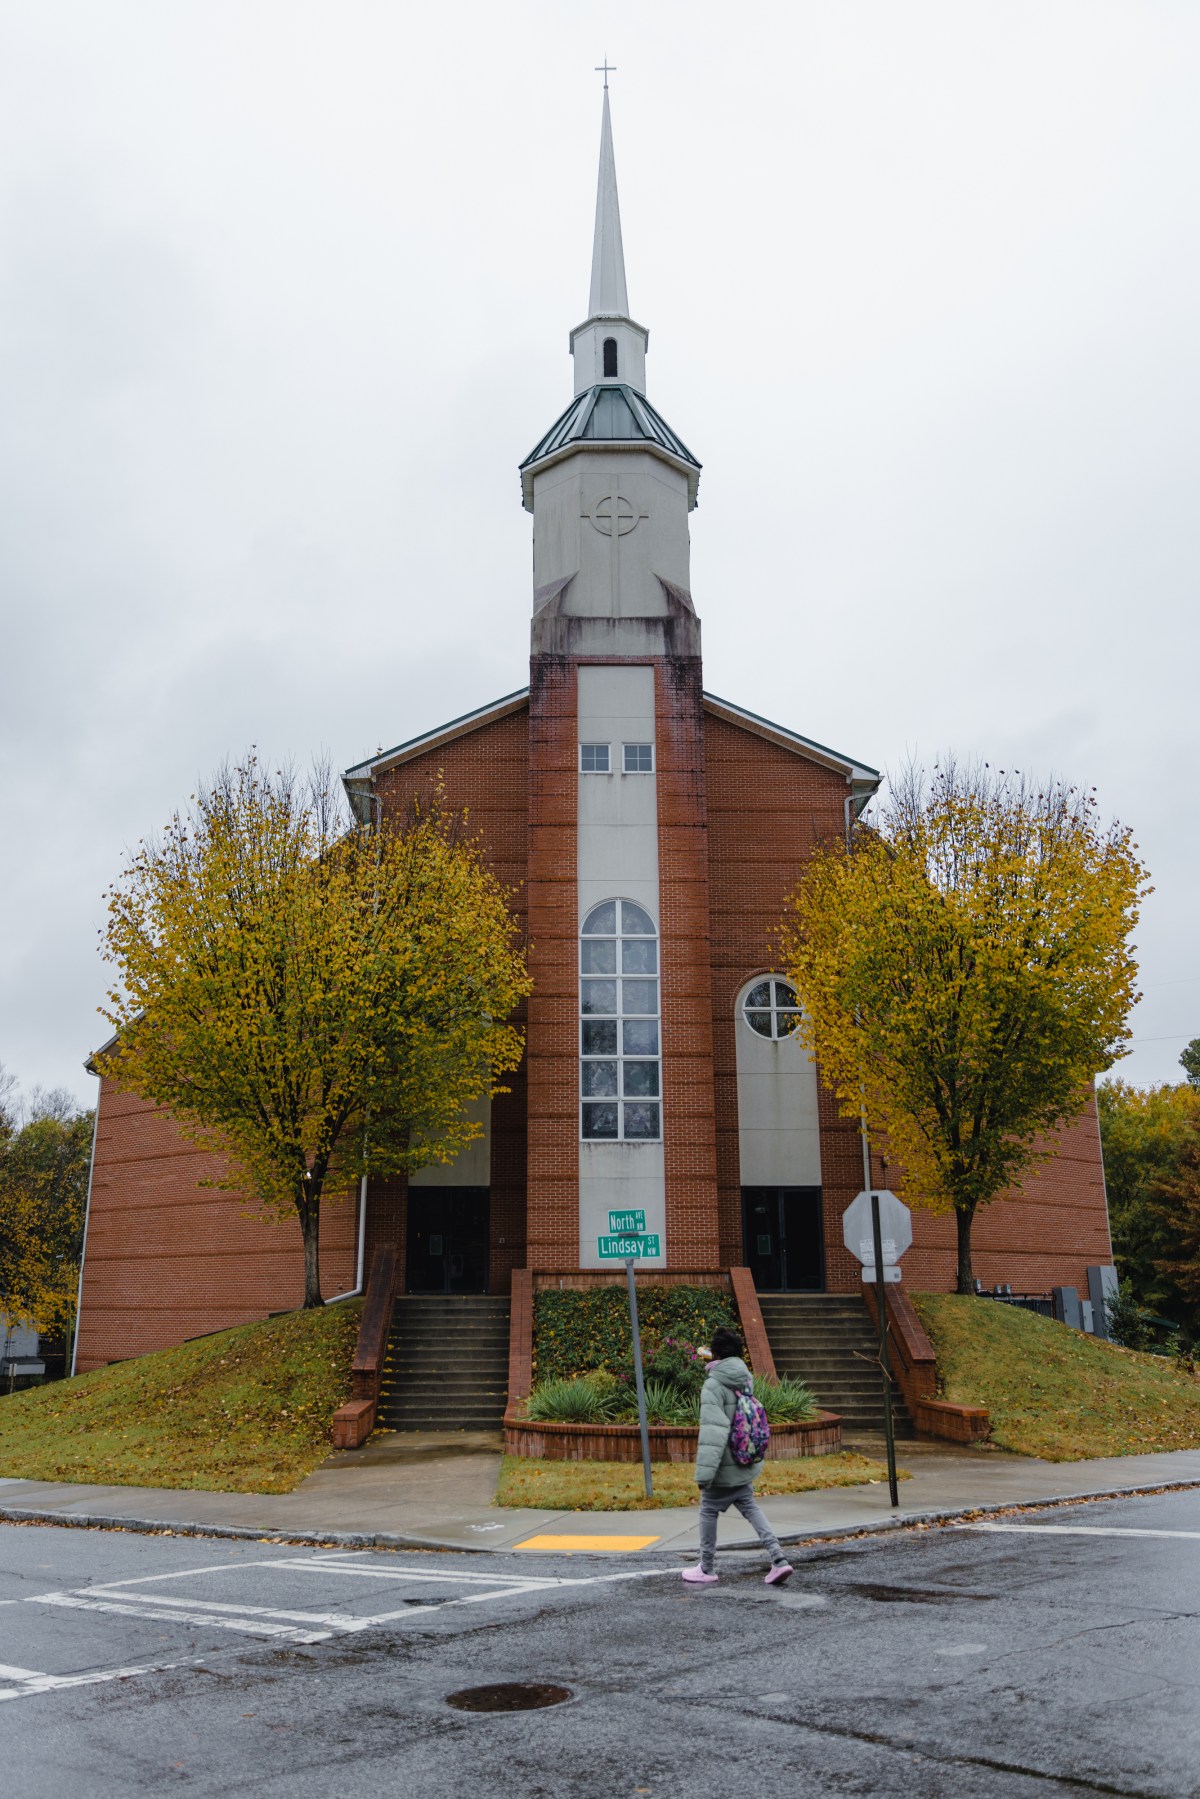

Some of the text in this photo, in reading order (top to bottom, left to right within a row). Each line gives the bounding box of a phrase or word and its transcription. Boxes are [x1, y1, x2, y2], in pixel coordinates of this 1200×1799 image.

[610, 1211, 643, 1230] North AVE
[601, 1236, 655, 1257] Lindsay ST
[648, 1247, 656, 1256] NW
